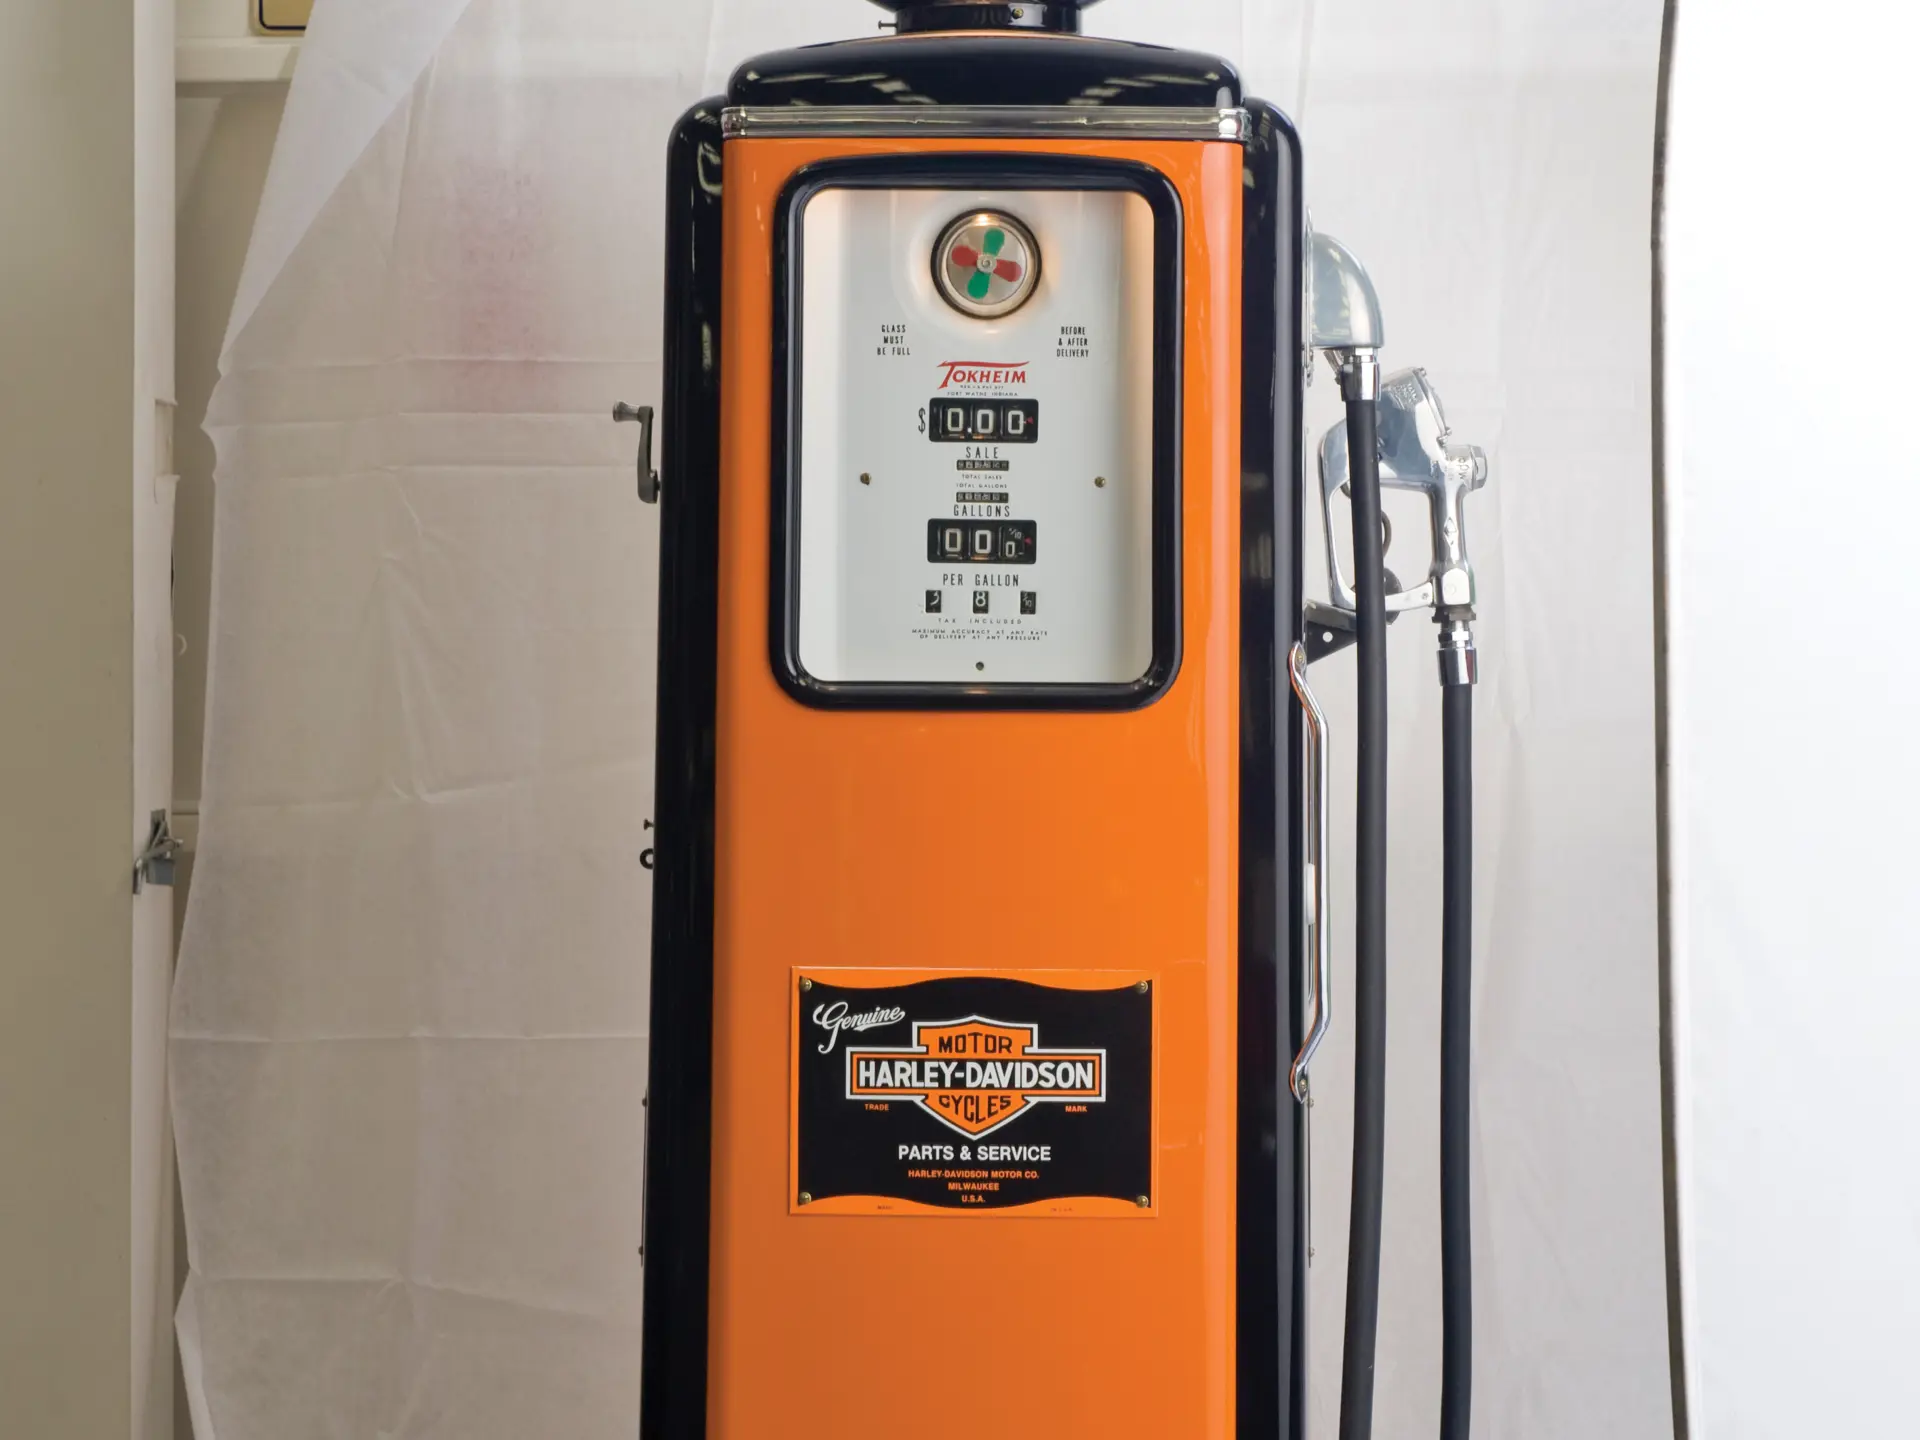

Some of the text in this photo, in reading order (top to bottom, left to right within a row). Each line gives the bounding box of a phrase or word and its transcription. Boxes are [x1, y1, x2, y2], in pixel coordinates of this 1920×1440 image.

[881, 324, 906, 333] GLASS
[1061, 326, 1086, 335] BEFORE
[883, 336, 904, 344] MUST
[1058, 338, 1088, 346] & AFTER
[877, 347, 911, 356] BE FULL
[1057, 349, 1089, 358] DELIVERY
[936, 361, 1030, 390] TOKHEIM
[918, 407, 926, 434] $
[966, 446, 998, 459] SALE
[954, 505, 1010, 517] GALLONS
[943, 574, 1019, 586] PER GALLON
[812, 1001, 905, 1054] Genuine
[938, 1032, 1013, 1054] MOTOR
[859, 1060, 1093, 1089] HARLEY-DAVIDSON
[864, 1103, 1087, 1113] TRADE MARK
[939, 1094, 1011, 1124] CYCLES
[898, 1145, 1051, 1161] PARTS & SERVICE
[908, 1170, 1040, 1179] HARLEY-DAVIDSON MOTOR CO.
[948, 1182, 999, 1191] MILWAUKEE
[962, 1195, 986, 1203] U.S.A.
